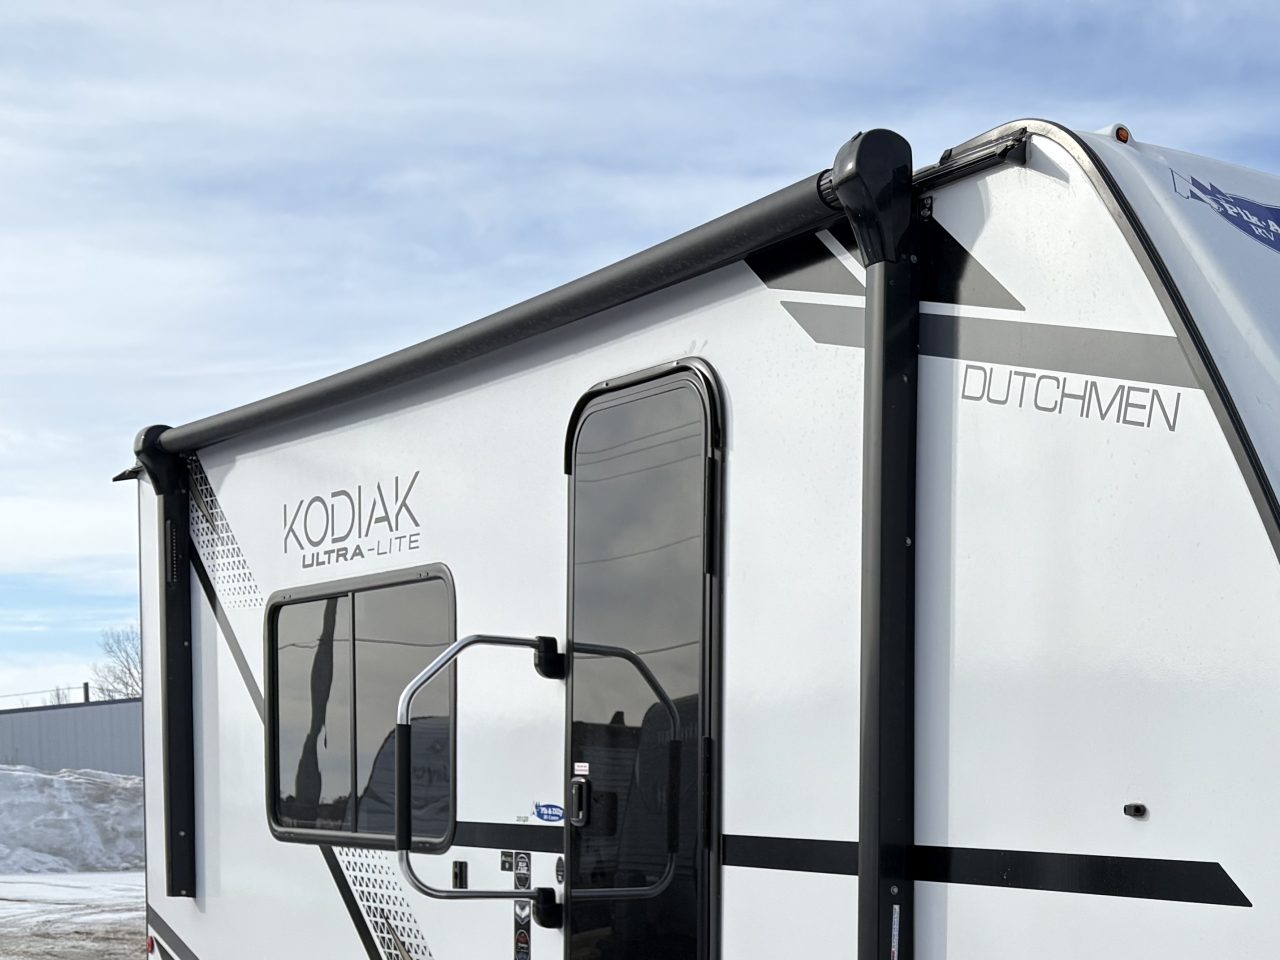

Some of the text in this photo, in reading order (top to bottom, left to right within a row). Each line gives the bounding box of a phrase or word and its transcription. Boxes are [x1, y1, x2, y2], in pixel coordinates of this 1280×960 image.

[1249, 223, 1275, 241] RV
[961, 364, 1181, 432] DUTCHMEN
[283, 470, 420, 554] KODIAK
[302, 532, 421, 569] ULTRA-LITE
